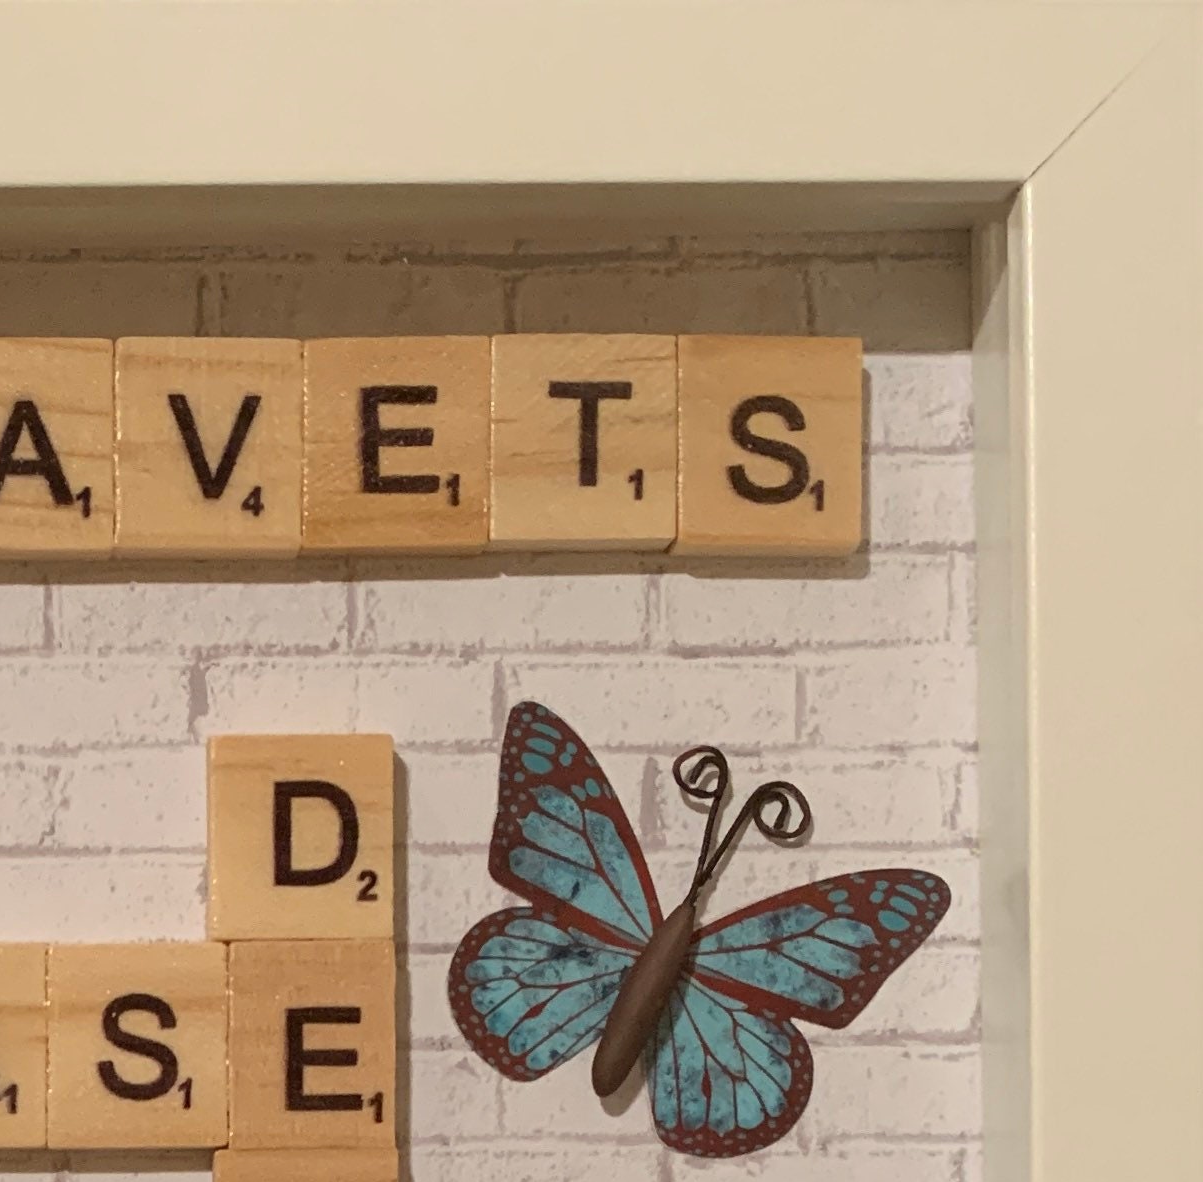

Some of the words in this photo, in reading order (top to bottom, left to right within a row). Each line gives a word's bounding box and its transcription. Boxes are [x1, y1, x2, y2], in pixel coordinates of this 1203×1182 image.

[74, 486, 93, 519] 1
[240, 486, 266, 517] 4
[444, 473, 462, 507] 1
[626, 468, 646, 500] 1
[808, 480, 826, 512] 1
[356, 870, 379, 902] 2
[1, 1084, 20, 1114] 1
[176, 1077, 194, 1110] 1
[366, 1091, 386, 1124] 1
